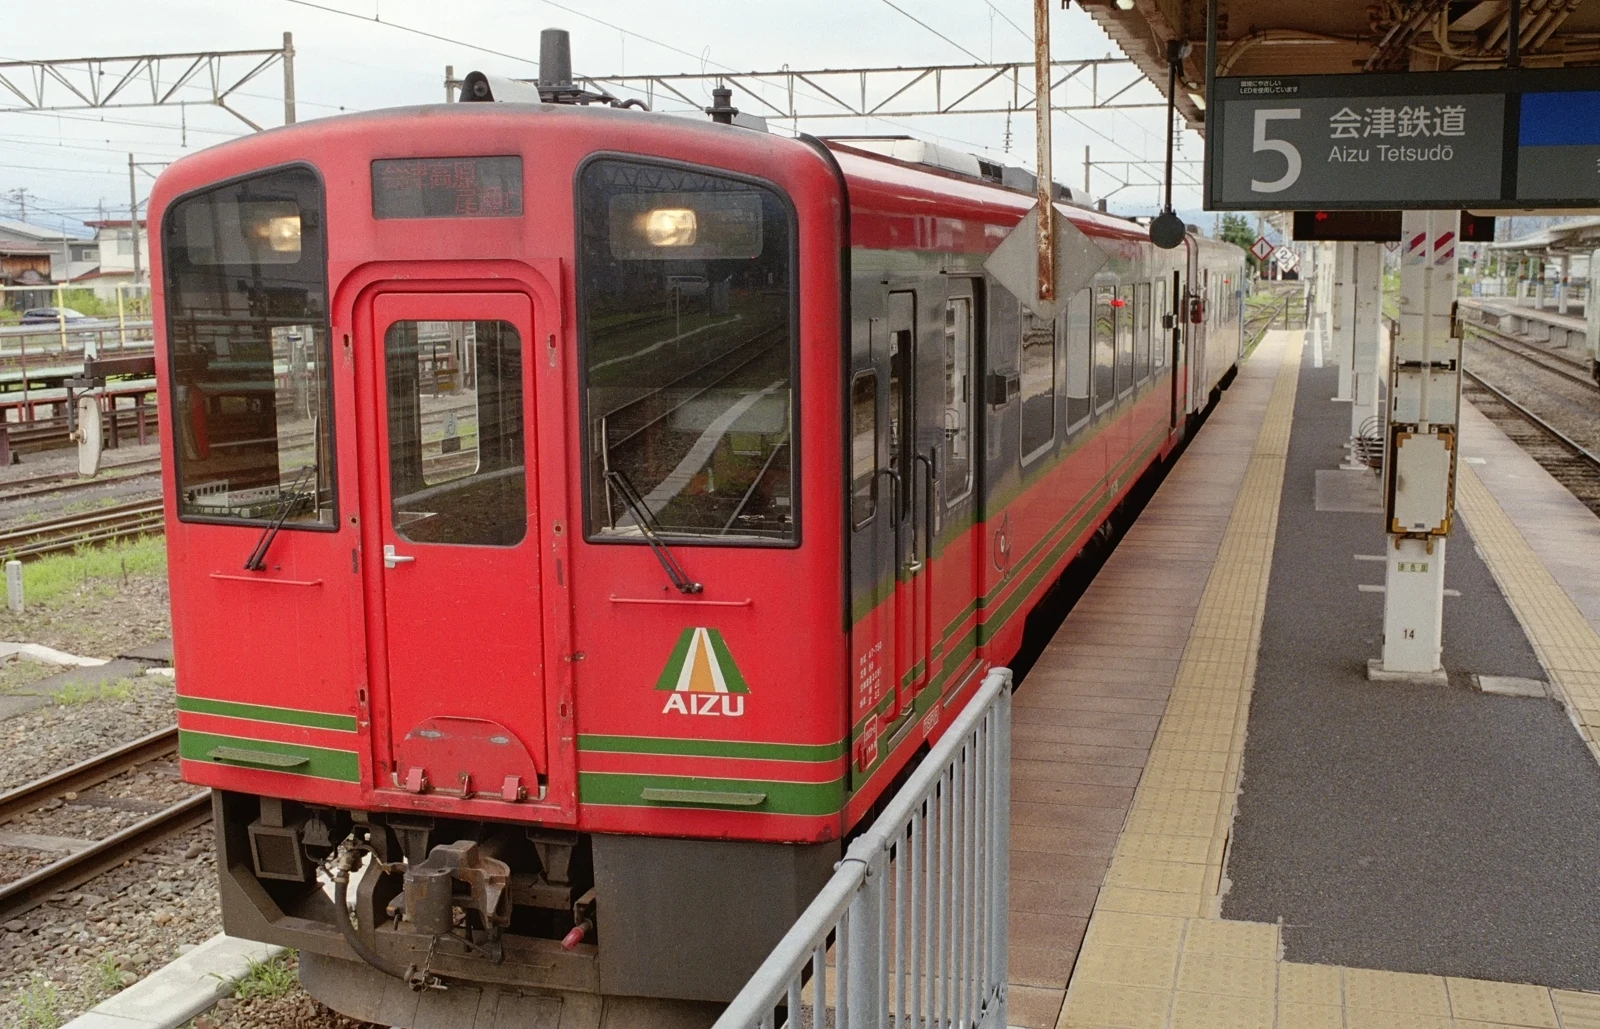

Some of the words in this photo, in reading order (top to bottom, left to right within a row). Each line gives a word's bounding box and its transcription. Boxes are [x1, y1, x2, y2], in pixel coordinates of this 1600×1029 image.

[1328, 104, 1466, 139] 会津鉄道
[1250, 108, 1302, 193] 5
[1328, 146, 1370, 162] Aizu
[1376, 144, 1454, 162] Tetsudō
[1403, 628, 1415, 640] 14
[662, 693, 744, 716] AIZU
